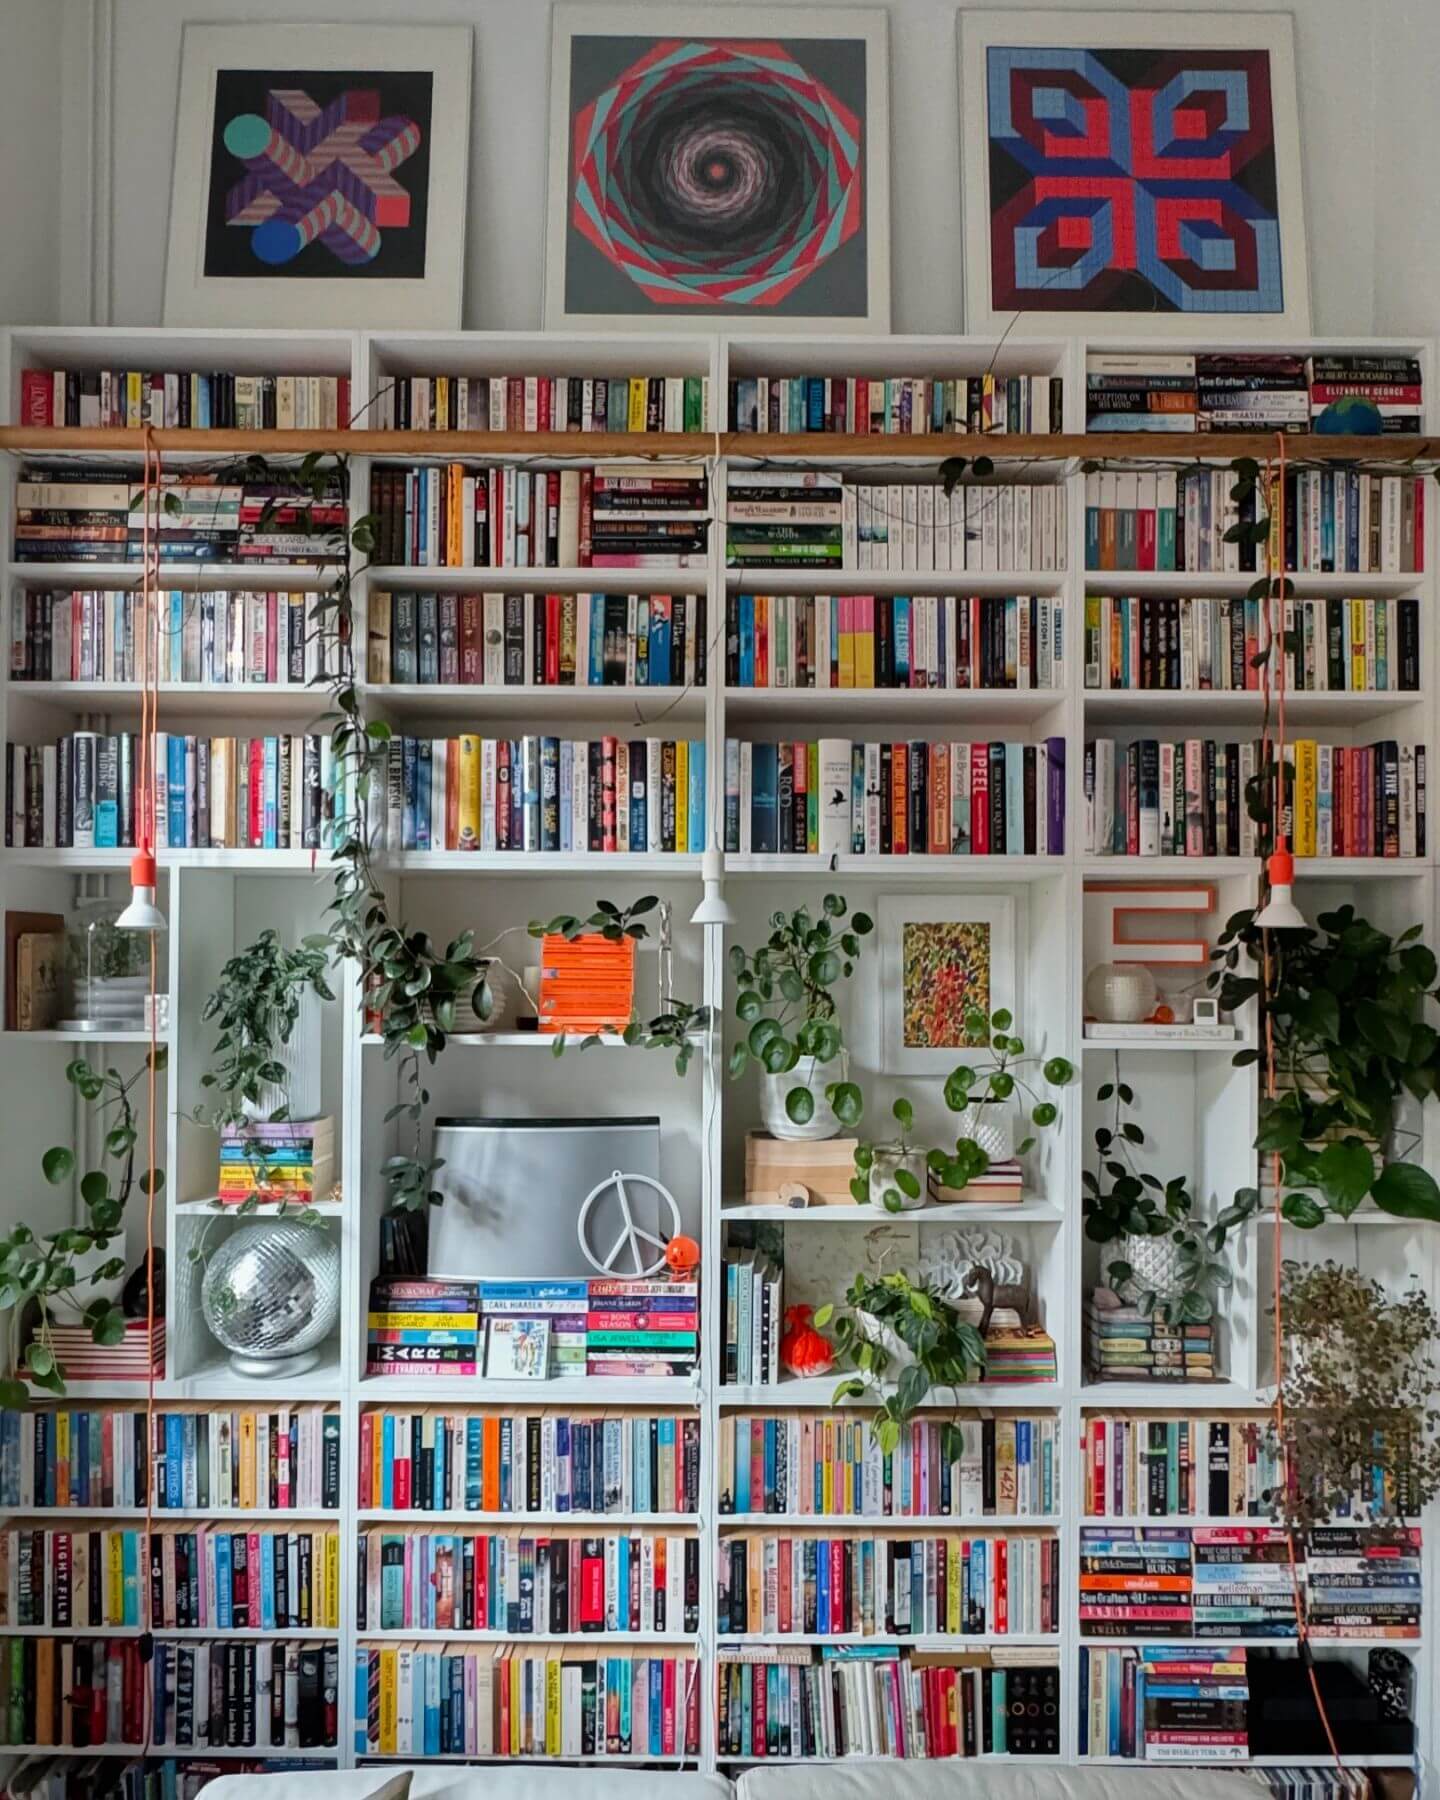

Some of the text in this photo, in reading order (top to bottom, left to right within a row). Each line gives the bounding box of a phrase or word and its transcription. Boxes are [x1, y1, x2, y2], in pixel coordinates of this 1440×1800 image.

[1326, 386, 1404, 396] ELIZABETH GEORGE
[897, 618, 909, 665] FELLSIDE
[389, 741, 401, 809] BILL BRYSON
[781, 776, 791, 808] ROD
[934, 766, 946, 810] BRYSON
[973, 760, 988, 795] PEEL
[1175, 757, 1184, 822] RACING TRIBE
[36, 1417, 44, 1452] sleepers
[502, 1428, 511, 1465] REVENANT
[169, 1459, 179, 1499] MYTHOS
[185, 1462, 194, 1497] HEROES
[328, 1460, 336, 1494] BARKER
[999, 1466, 1015, 1499] 1421
[58, 1535, 68, 1621] NIGHT FILM
[1146, 1563, 1177, 1574] BURN
[768, 1567, 777, 1614] Middlesex
